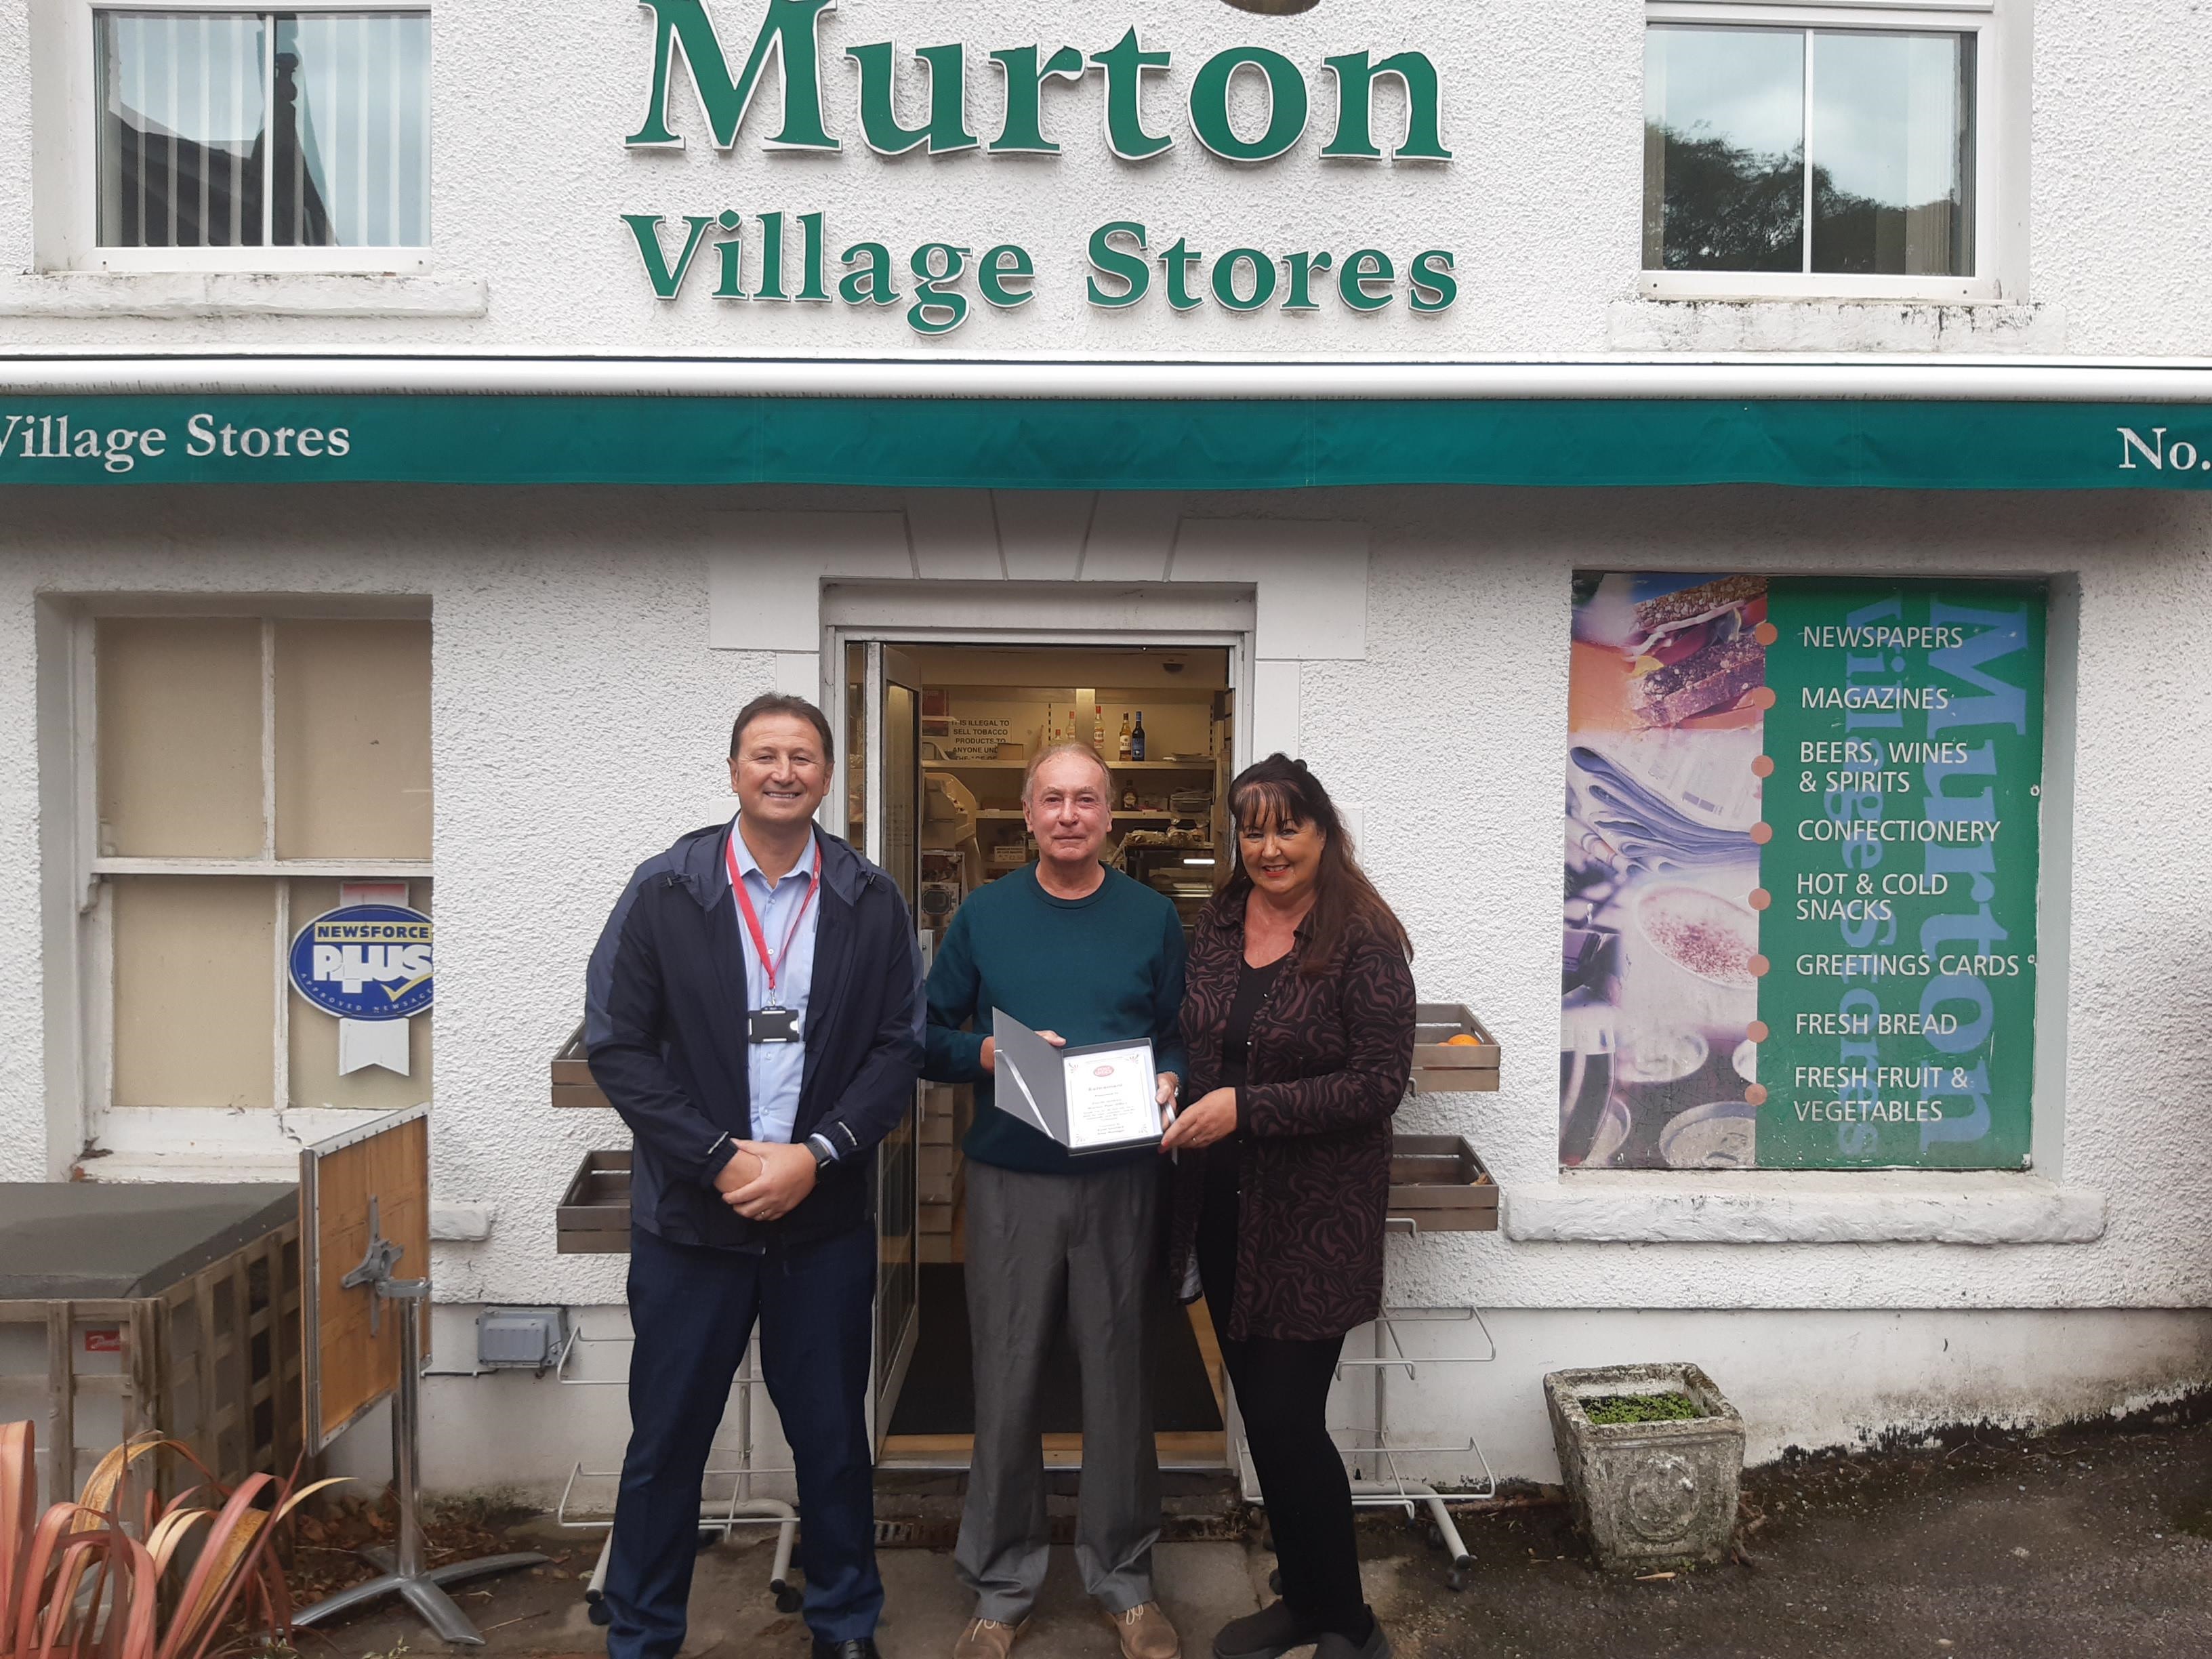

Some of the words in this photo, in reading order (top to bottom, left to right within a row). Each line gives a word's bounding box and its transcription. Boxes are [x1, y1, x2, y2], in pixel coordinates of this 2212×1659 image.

[623, 0, 1453, 161] Murton
[619, 209, 1037, 336] Village
[1084, 220, 1458, 314] Stores
[186, 413, 350, 458] Stores
[2116, 428, 2211, 470] No.
[1803, 626, 1963, 649] NEWSPAPERS
[1801, 687, 1949, 710] MAGAZINES
[1824, 594, 1906, 869] Village
[1800, 741, 1879, 766] BEERS,
[1889, 742, 1968, 764] WINES
[1799, 771, 1817, 792] &
[1826, 771, 1910, 792] SPIRITS
[1797, 819, 2001, 842] CONFECTIONERY
[1797, 873, 1848, 895] HOT
[1856, 873, 1873, 895] &
[1882, 873, 1948, 895] COLD
[1919, 593, 2028, 1153] Murton
[1796, 899, 1891, 921] SNACKS
[317, 926, 429, 939] NEWSFORCE
[313, 944, 433, 994] PLUS
[1796, 954, 1930, 977] GREETINGS
[1940, 954, 2020, 977] CARDS
[301, 972, 363, 1011] APPROVED
[1795, 1013, 1868, 1036] FRESH
[1879, 1014, 1958, 1036] BREAD
[1795, 1067, 1868, 1088] FRESH
[1877, 1067, 1944, 1088] FRUIT
[1951, 1067, 1968, 1088] &
[1794, 1101, 1943, 1122] VEGETABLES
